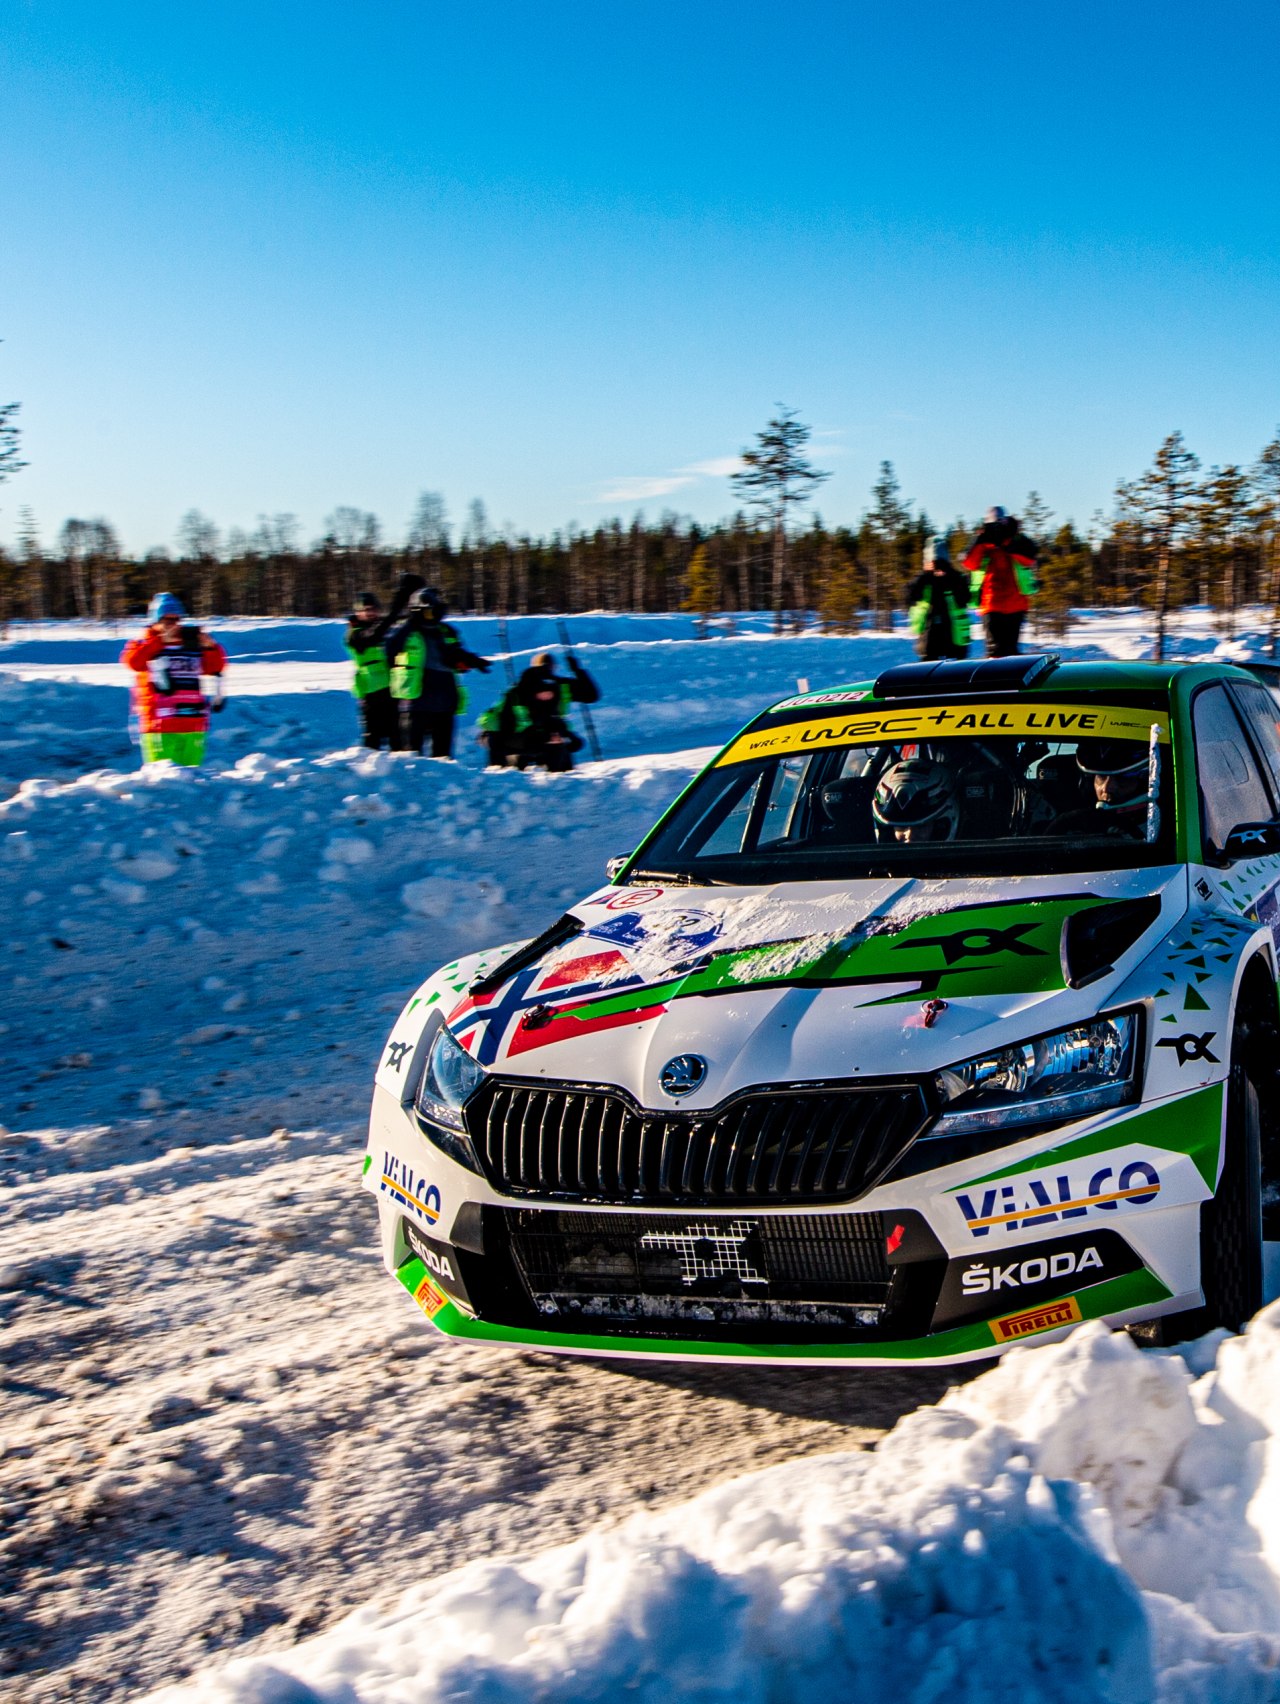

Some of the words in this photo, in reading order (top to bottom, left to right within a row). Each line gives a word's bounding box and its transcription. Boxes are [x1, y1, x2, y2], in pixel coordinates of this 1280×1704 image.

[750, 738, 779, 750] WRC
[782, 736, 791, 744] 2
[955, 713, 1015, 729] ALL
[1026, 713, 1099, 730] LIVE
[408, 1226, 455, 1281] ŠKODA
[962, 1247, 1104, 1295] ŠKODA
[998, 1302, 1074, 1338] PIRELLI
